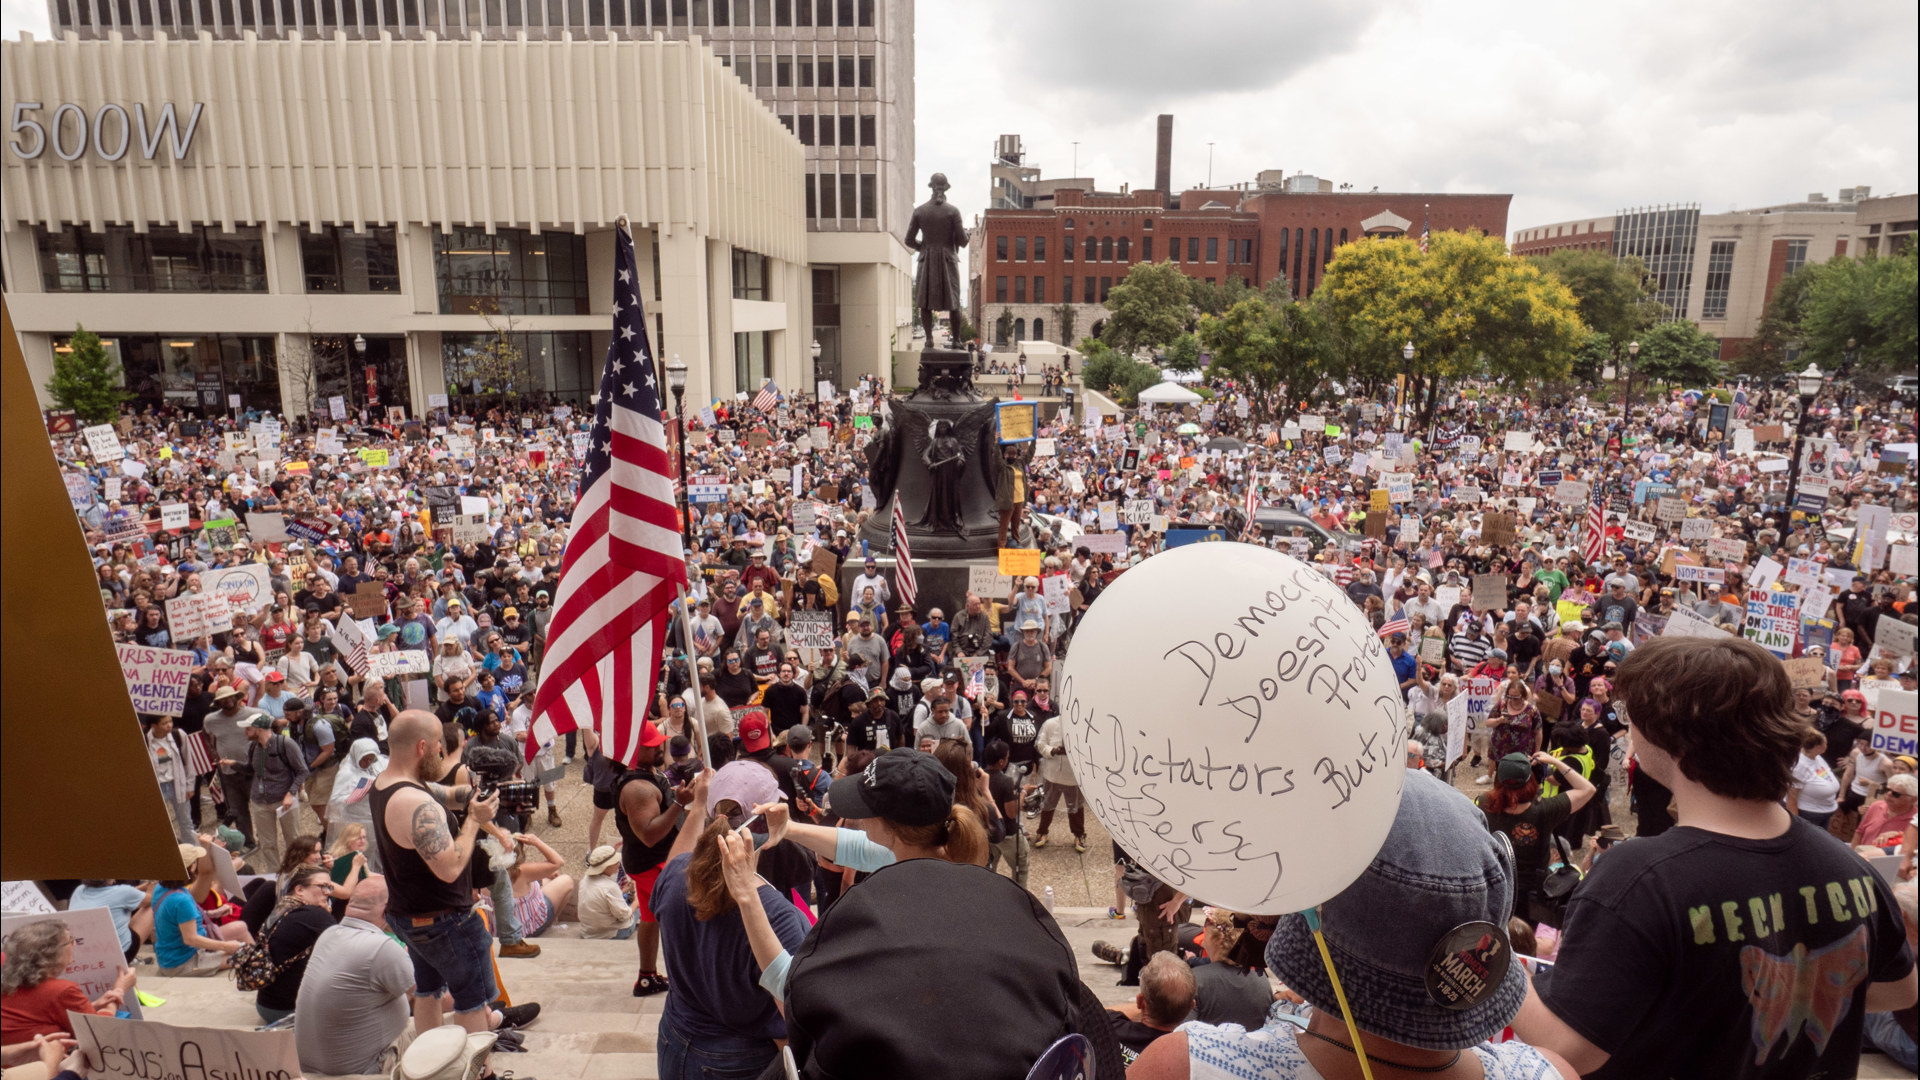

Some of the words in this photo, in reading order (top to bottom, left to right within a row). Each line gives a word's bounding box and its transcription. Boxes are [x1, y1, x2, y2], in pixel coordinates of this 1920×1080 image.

[9, 102, 204, 161] 500W
[233, 432, 247, 440] NO
[1135, 501, 1149, 511] NO
[1750, 590, 1768, 602] NO
[1771, 593, 1796, 608] ONE
[1747, 602, 1765, 615] IS
[791, 622, 806, 633] SAY
[806, 622, 818, 633] NO
[1747, 616, 1761, 628] ON
[804, 634, 831, 647] KINGS
[1755, 631, 1791, 647] LAND
[119, 648, 156, 665] IRLS
[161, 652, 195, 667] JUST
[151, 669, 189, 685] HAVE
[130, 684, 185, 699] MENTAL
[133, 700, 184, 712] RIGHTS
[1012, 723, 1036, 738] LIVES
[1106, 712, 1296, 798] Dictators
[66, 961, 106, 974] EOPLE
[1440, 952, 1487, 997] MARCH
